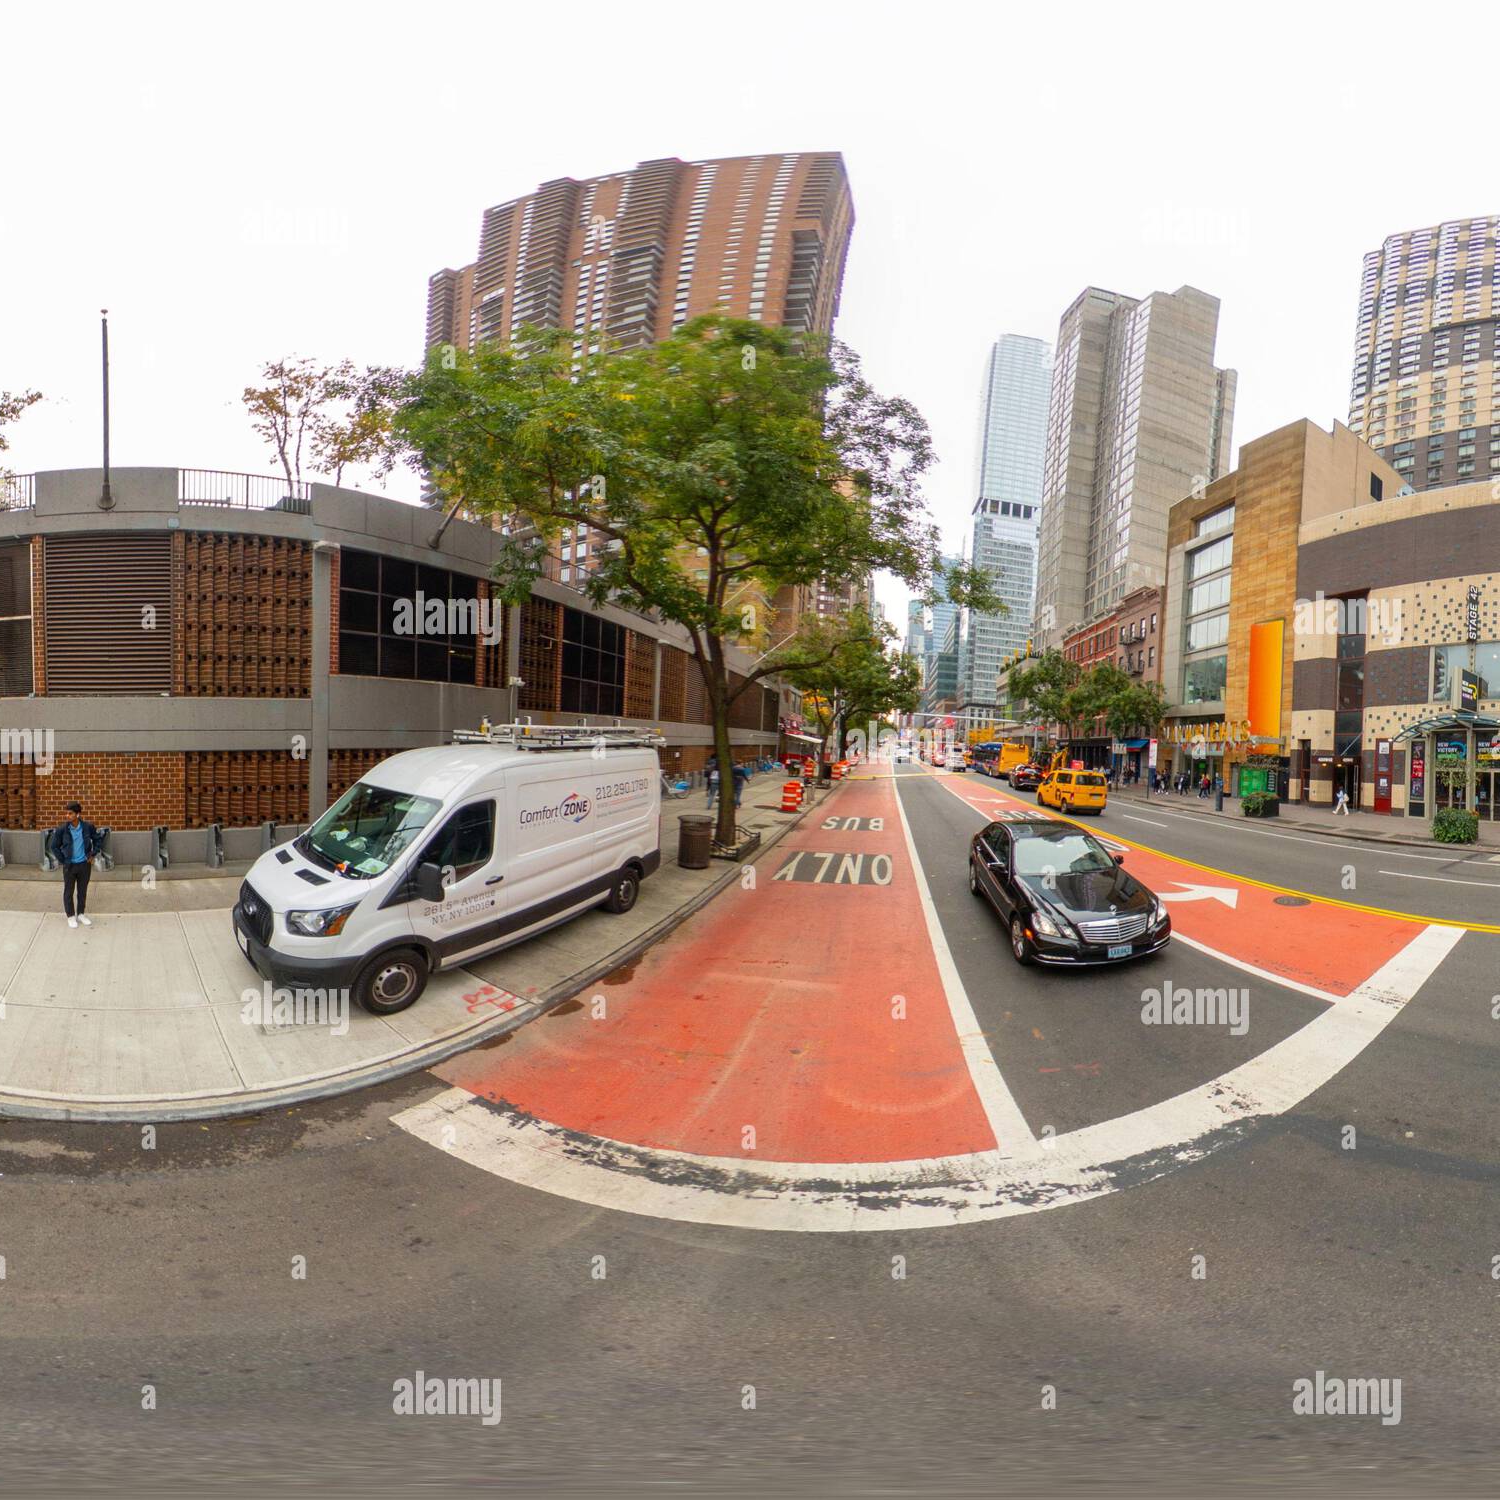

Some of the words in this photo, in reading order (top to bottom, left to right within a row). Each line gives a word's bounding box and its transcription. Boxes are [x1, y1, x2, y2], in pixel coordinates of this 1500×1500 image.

[1470, 586, 1478, 601] 42
[1469, 602, 1478, 640] STAGE
[520, 804, 559, 824] Comfort
[564, 800, 588, 816] ZONE
[821, 816, 884, 832] BUS
[772, 851, 893, 885] ONLY
[461, 890, 496, 906] Avenue
